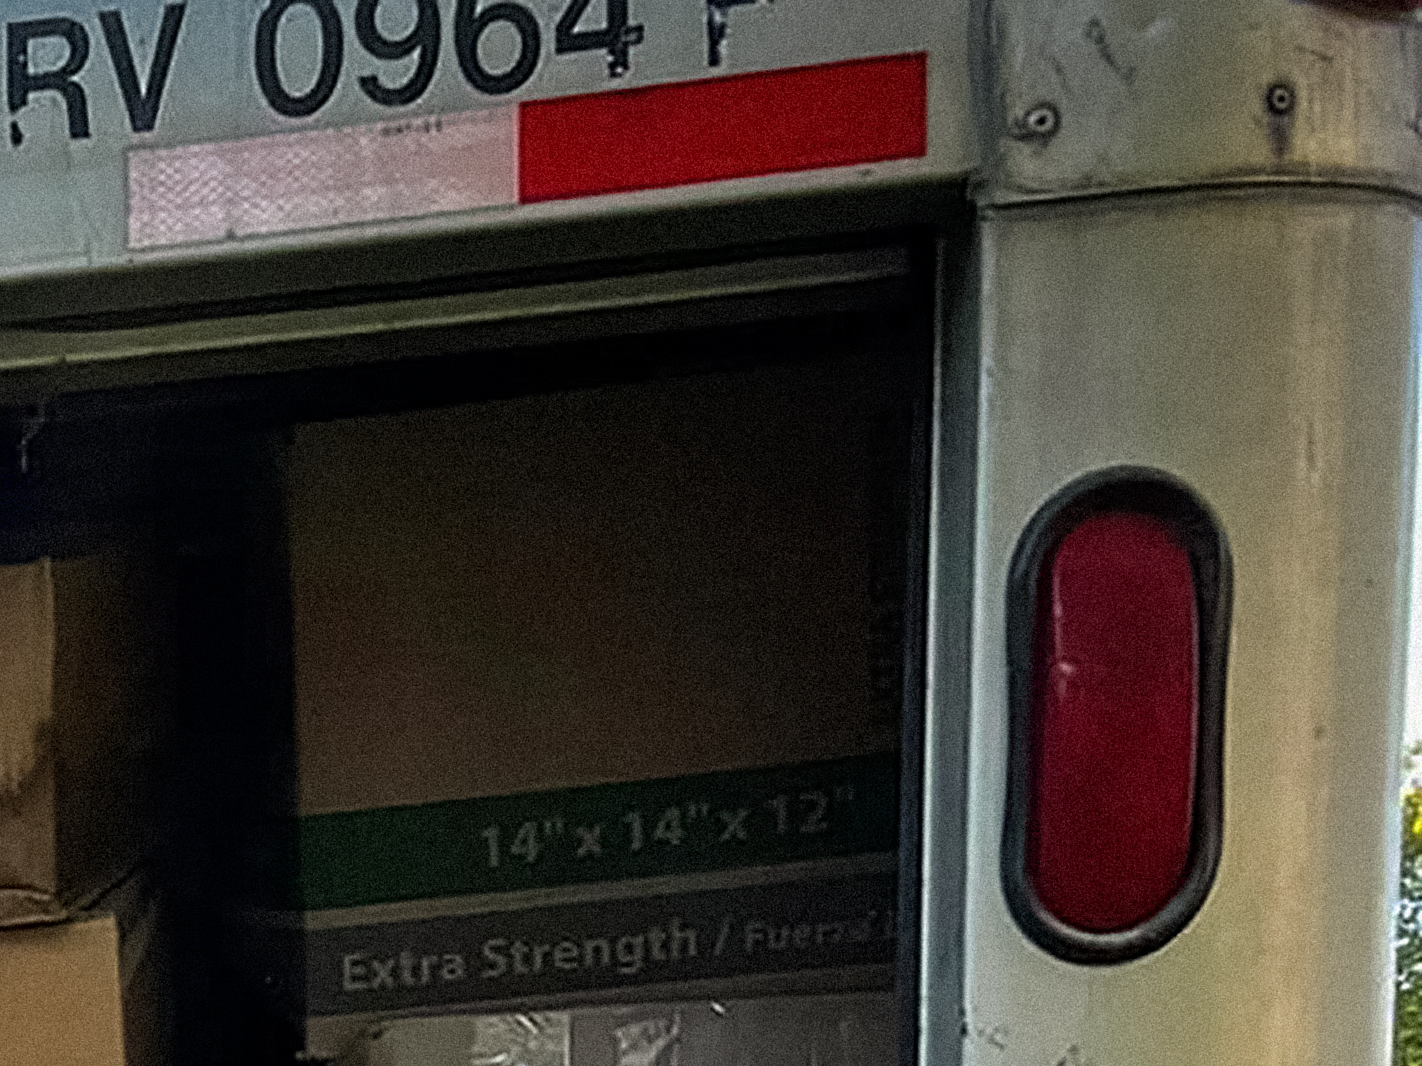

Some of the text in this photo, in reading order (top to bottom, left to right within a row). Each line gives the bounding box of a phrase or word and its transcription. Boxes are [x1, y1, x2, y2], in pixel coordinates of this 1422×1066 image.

[3, 0, 186, 146] RV
[252, 0, 645, 119] 0964
[574, 820, 605, 859] x
[719, 803, 752, 843] x
[341, 947, 466, 992] Extra
[479, 922, 699, 976] Strength
